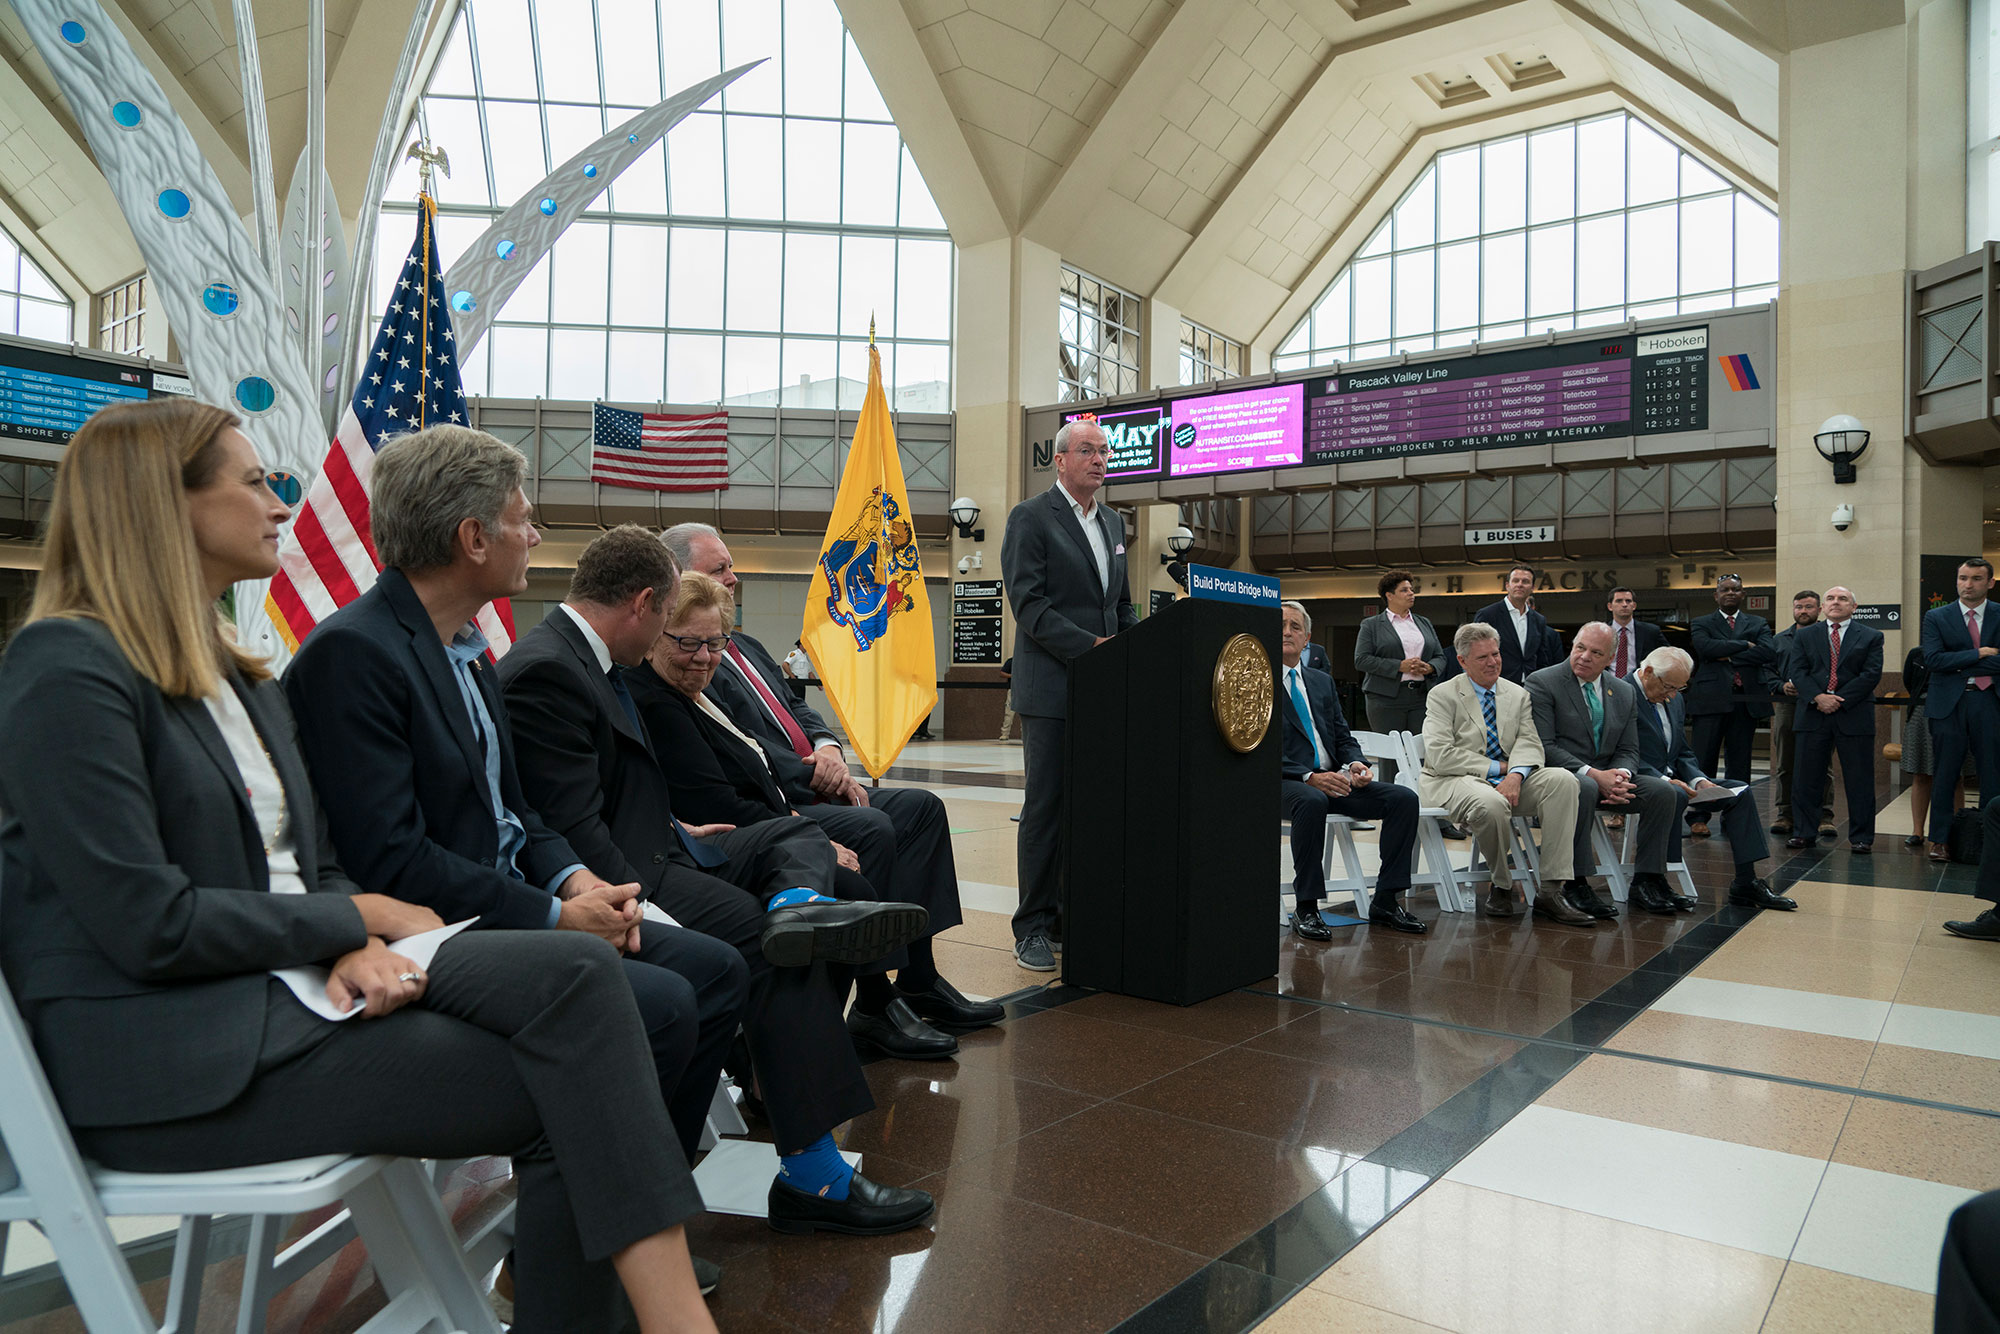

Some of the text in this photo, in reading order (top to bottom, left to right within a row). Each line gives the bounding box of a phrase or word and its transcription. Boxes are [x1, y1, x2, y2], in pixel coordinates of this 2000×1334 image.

[1650, 335, 1704, 350] Hoboken
[1646, 366, 1680, 377] 11:23
[1349, 369, 1448, 389] Pascack Valley Line
[1646, 379, 1680, 390] 11:34
[174, 385, 192, 393] YORK
[1318, 406, 1344, 415] 11:25
[1502, 383, 1545, 394] Wood-Ridge
[1562, 379, 1585, 387] Essex
[1586, 376, 1609, 384] Street
[1646, 392, 1680, 403] 11:50
[1317, 418, 1344, 427] 12:45
[1351, 415, 1370, 423] Spring
[1501, 396, 1545, 406] Wood-Ridge
[1562, 390, 1597, 399] Teterboro
[1646, 406, 1679, 415] 12:01
[1321, 429, 1343, 437] 2:00
[1350, 426, 1370, 434] Spring
[1501, 408, 1545, 419] Wood-Ridge
[1562, 402, 1597, 412] Teterboro
[1646, 418, 1680, 428] 12:52
[16, 426, 54, 437] SHORE
[1320, 440, 1343, 448] 3:08
[1501, 420, 1544, 431] Wood-Ridge
[1562, 414, 1597, 424] Teterboro
[1316, 449, 1364, 459] TRANSFER
[1389, 442, 1434, 452] HOBOKEN
[1462, 437, 1488, 446] HBLR
[1496, 434, 1517, 442] AND
[1547, 425, 1606, 437] WATERWAY
[1033, 439, 1053, 467] NJ
[1121, 449, 1135, 458] ask
[1135, 448, 1152, 456] how
[1107, 456, 1153, 468] we're doing?
[1487, 530, 1533, 541] BUSES
[1446, 566, 1717, 593] H TACKS E F
[1193, 574, 1278, 599] Build Portal Bridge Now
[1751, 598, 1766, 608] EXIT
